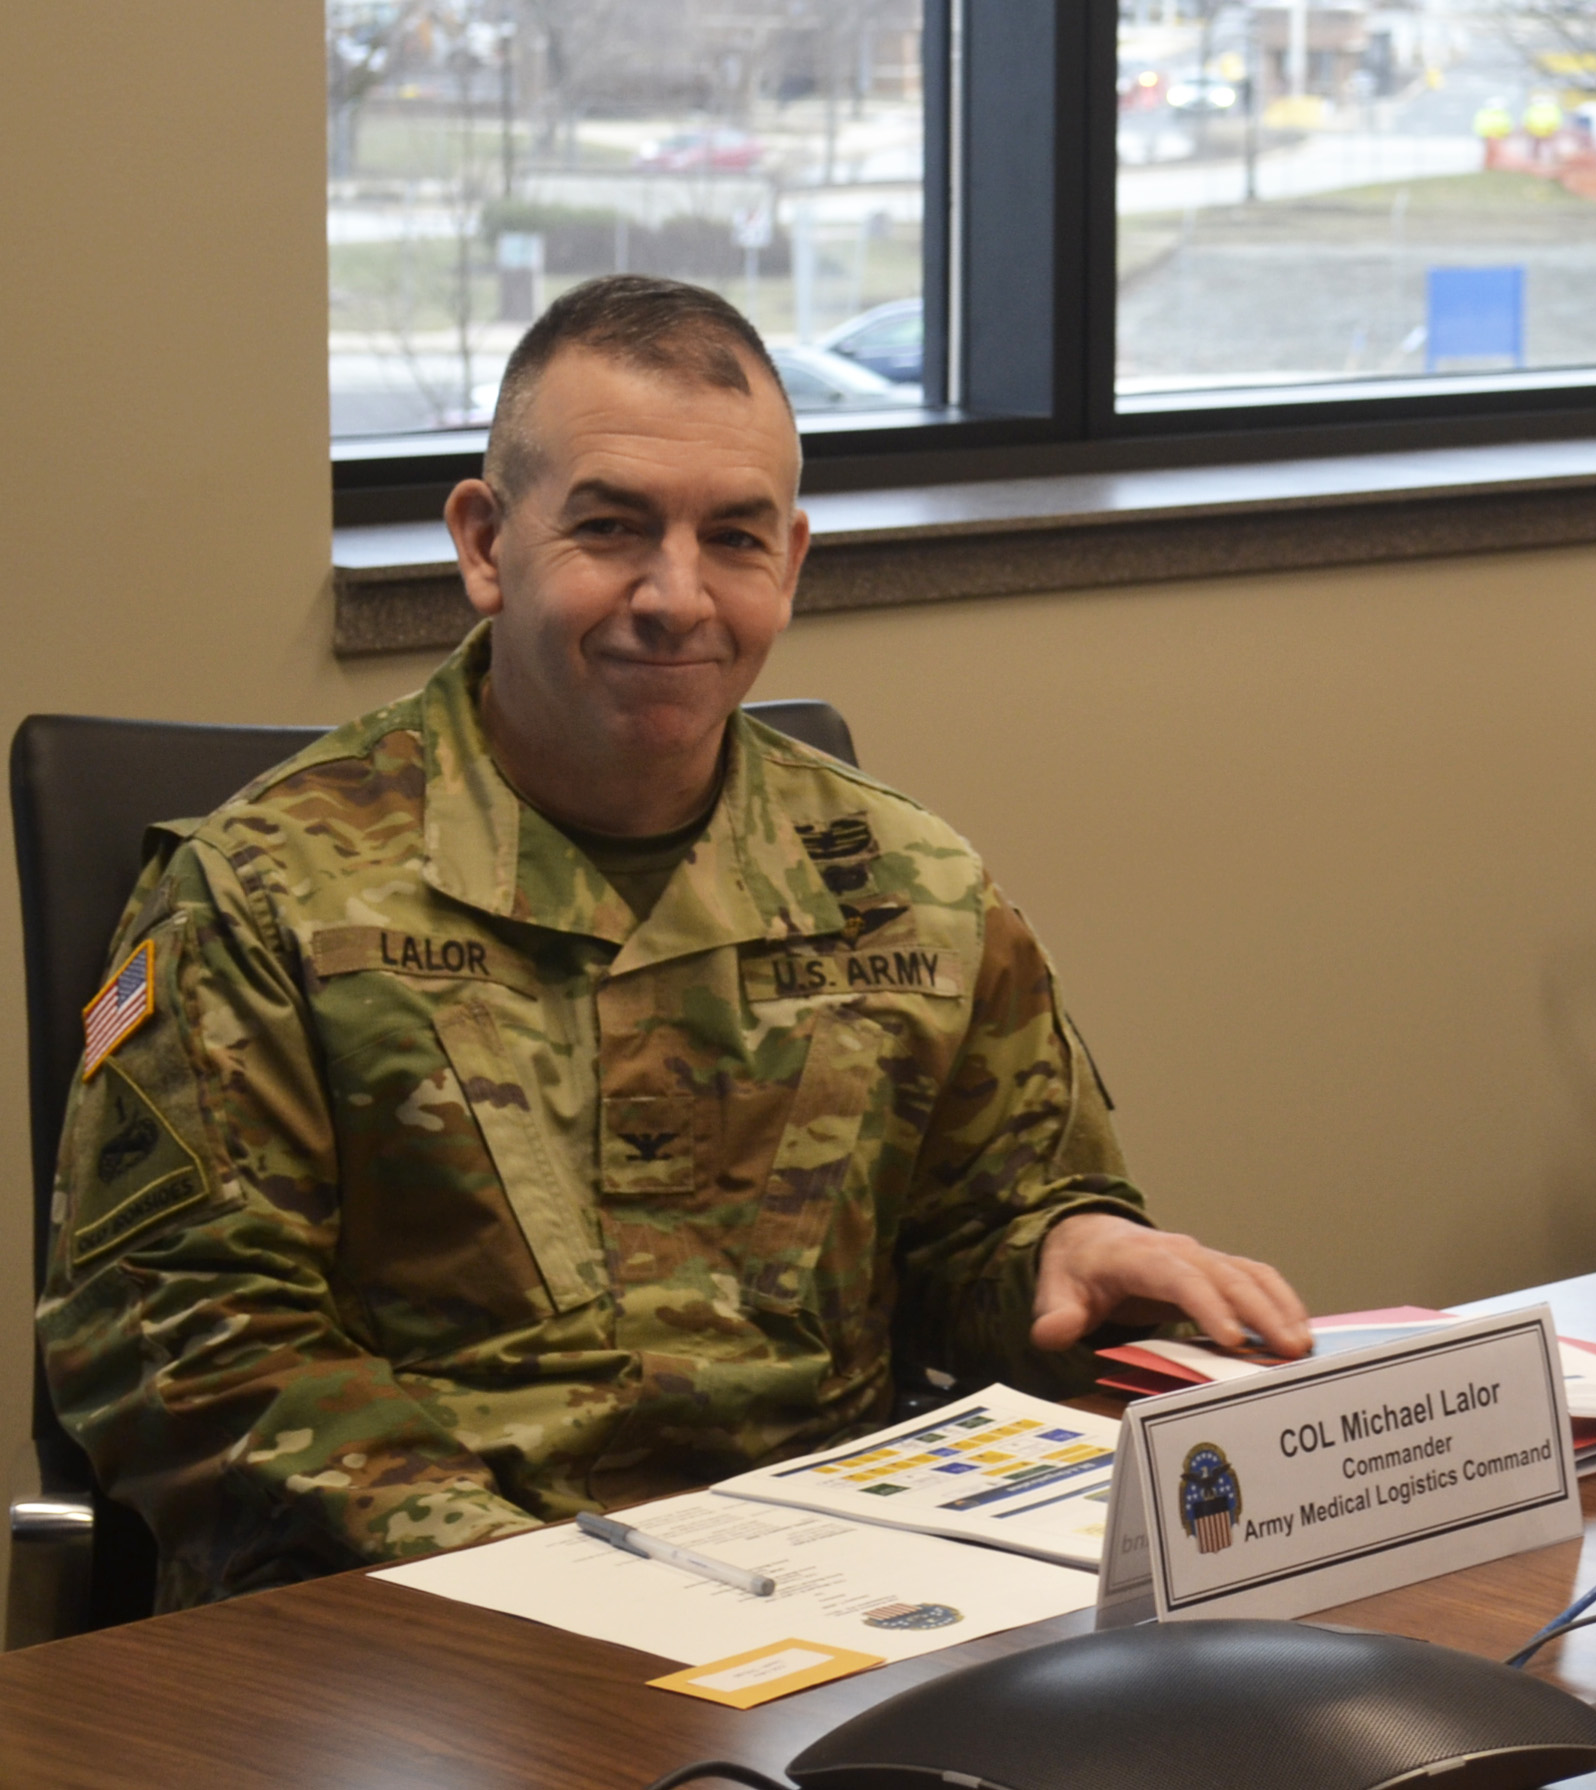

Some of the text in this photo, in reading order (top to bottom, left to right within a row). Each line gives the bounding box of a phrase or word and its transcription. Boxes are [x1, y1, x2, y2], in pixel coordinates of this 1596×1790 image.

[380, 931, 491, 976] LALOR
[772, 951, 939, 992] U.S. ARMY
[1279, 1381, 1501, 1458] COL Michael Lalor
[1341, 1435, 1453, 1479] Commander
[1243, 1437, 1552, 1543] Army Medical Logistics Command
